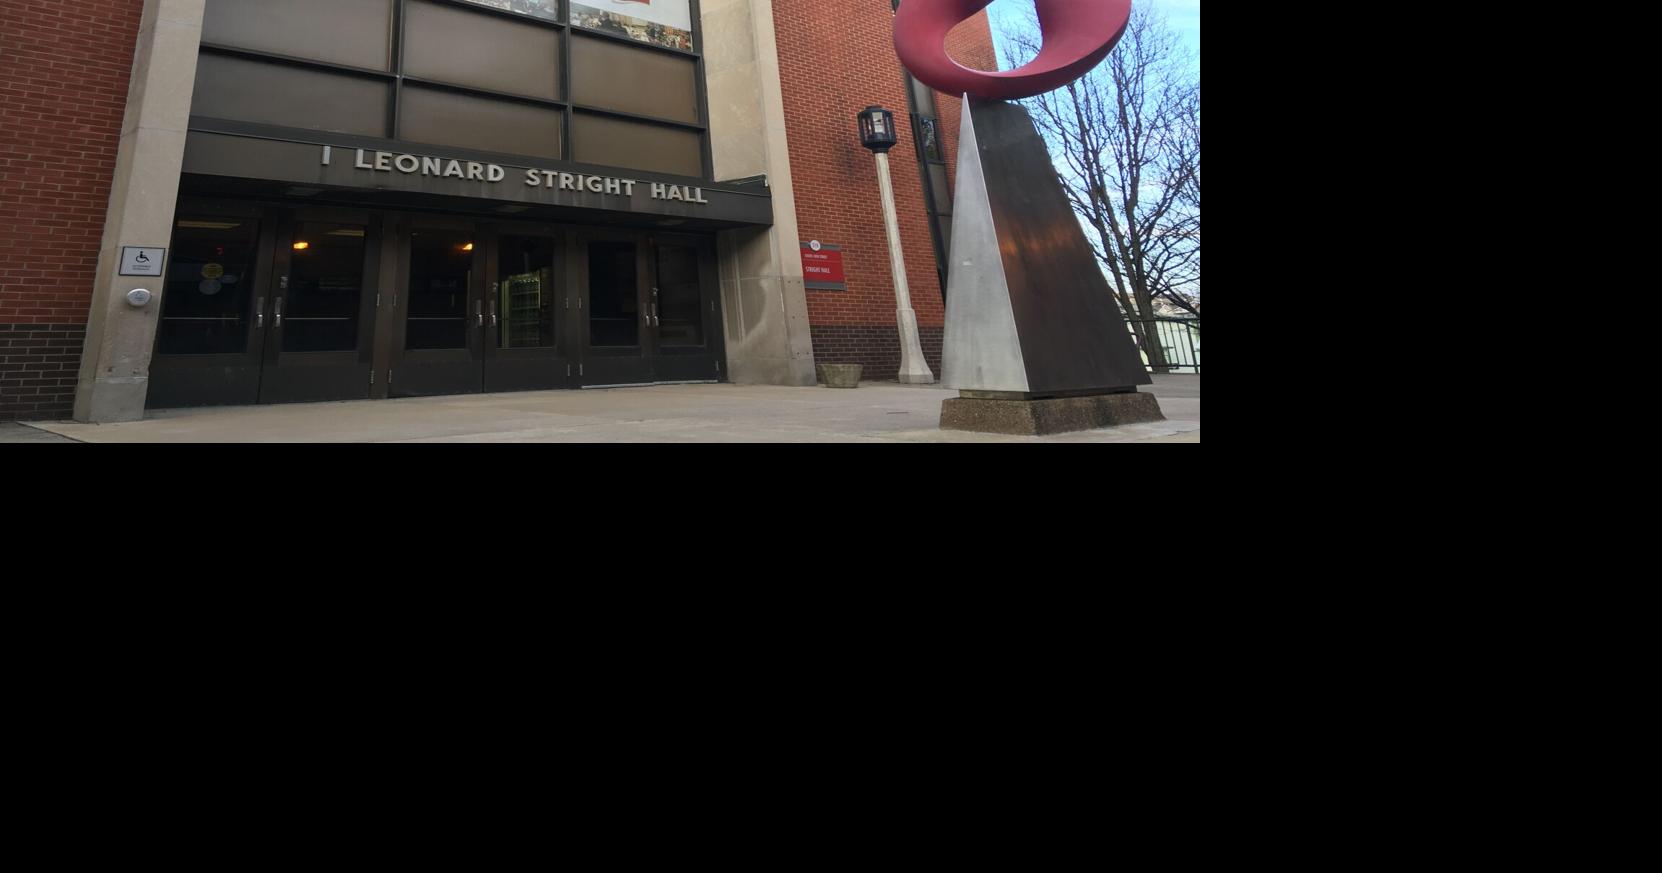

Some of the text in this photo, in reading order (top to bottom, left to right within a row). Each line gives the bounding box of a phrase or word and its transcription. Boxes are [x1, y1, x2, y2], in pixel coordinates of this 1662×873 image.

[355, 148, 505, 182] LEONARD
[525, 168, 636, 197] STRIGHT
[650, 182, 708, 203] HALL
